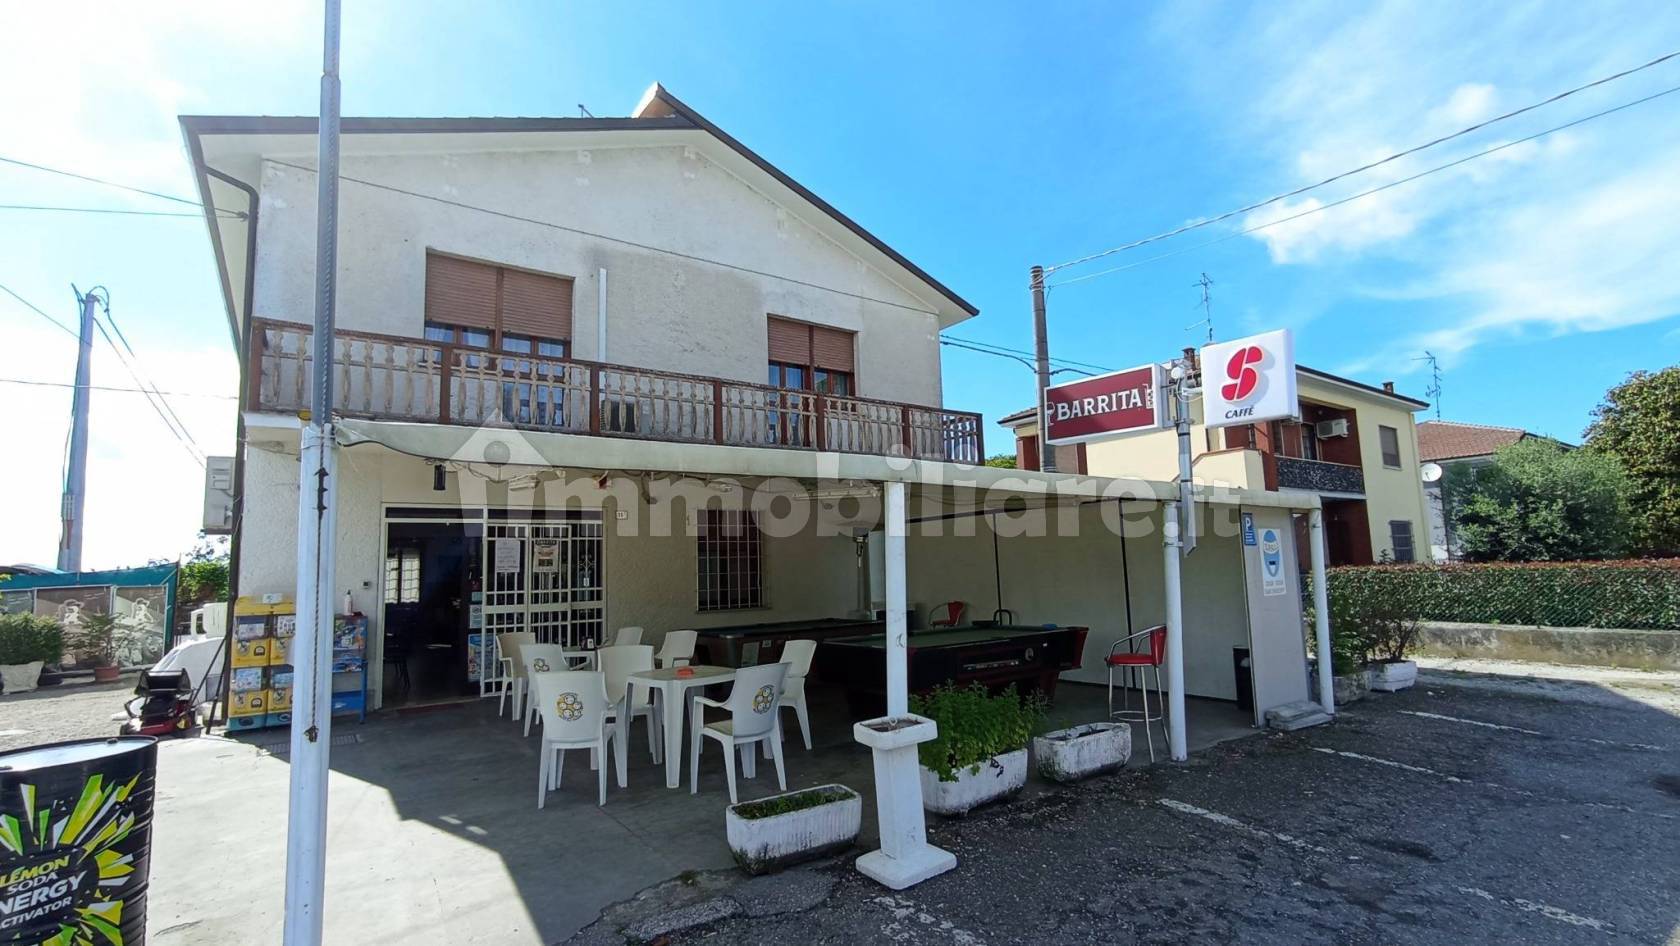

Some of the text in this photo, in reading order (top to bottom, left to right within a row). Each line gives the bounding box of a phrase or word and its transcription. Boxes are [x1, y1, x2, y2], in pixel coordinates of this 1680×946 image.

[1056, 388, 1143, 421] BARRITA
[0, 854, 70, 888] LEMON
[5, 870, 59, 895] SODA
[0, 870, 88, 914] NERGY
[0, 896, 72, 929] CTIVATOR
